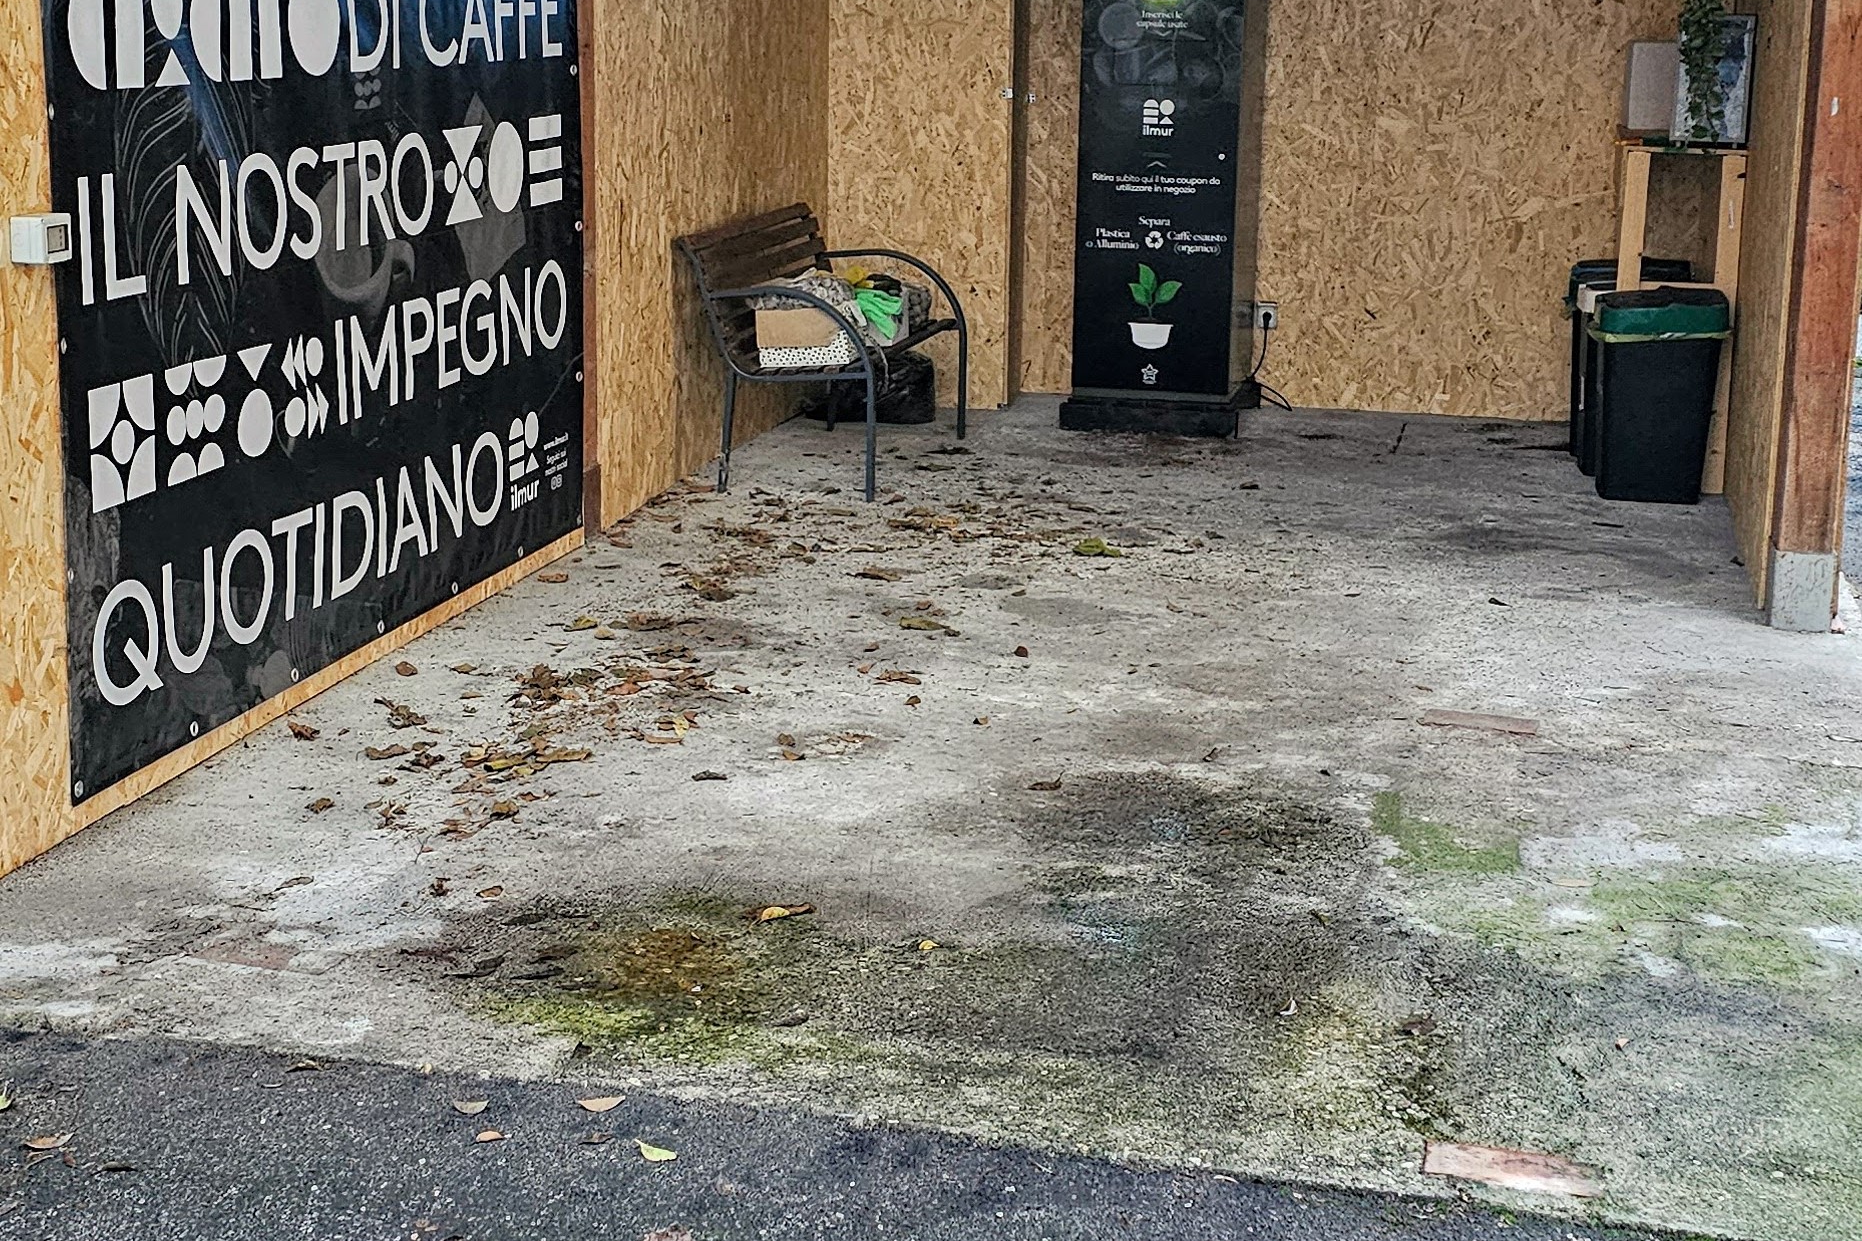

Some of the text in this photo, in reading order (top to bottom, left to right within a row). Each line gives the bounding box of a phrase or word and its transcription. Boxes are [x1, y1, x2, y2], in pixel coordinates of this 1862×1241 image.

[1142, 125, 1174, 137] ilmur
[1092, 172, 1114, 182] Ritira
[1115, 174, 1140, 182] subito
[1141, 175, 1153, 184] qui
[1160, 176, 1175, 184] tuo
[1176, 177, 1208, 186] coupon
[1209, 177, 1221, 186] da
[1116, 184, 1197, 195] utilizzare in negozio
[77, 132, 433, 306] IL NOSTRO
[1138, 216, 1171, 228] Separa
[1095, 228, 1131, 239] Plastica
[335, 260, 566, 425] IMPEGNO
[510, 479, 540, 512] ilmur
[92, 431, 503, 706] QUOTIDIANO
